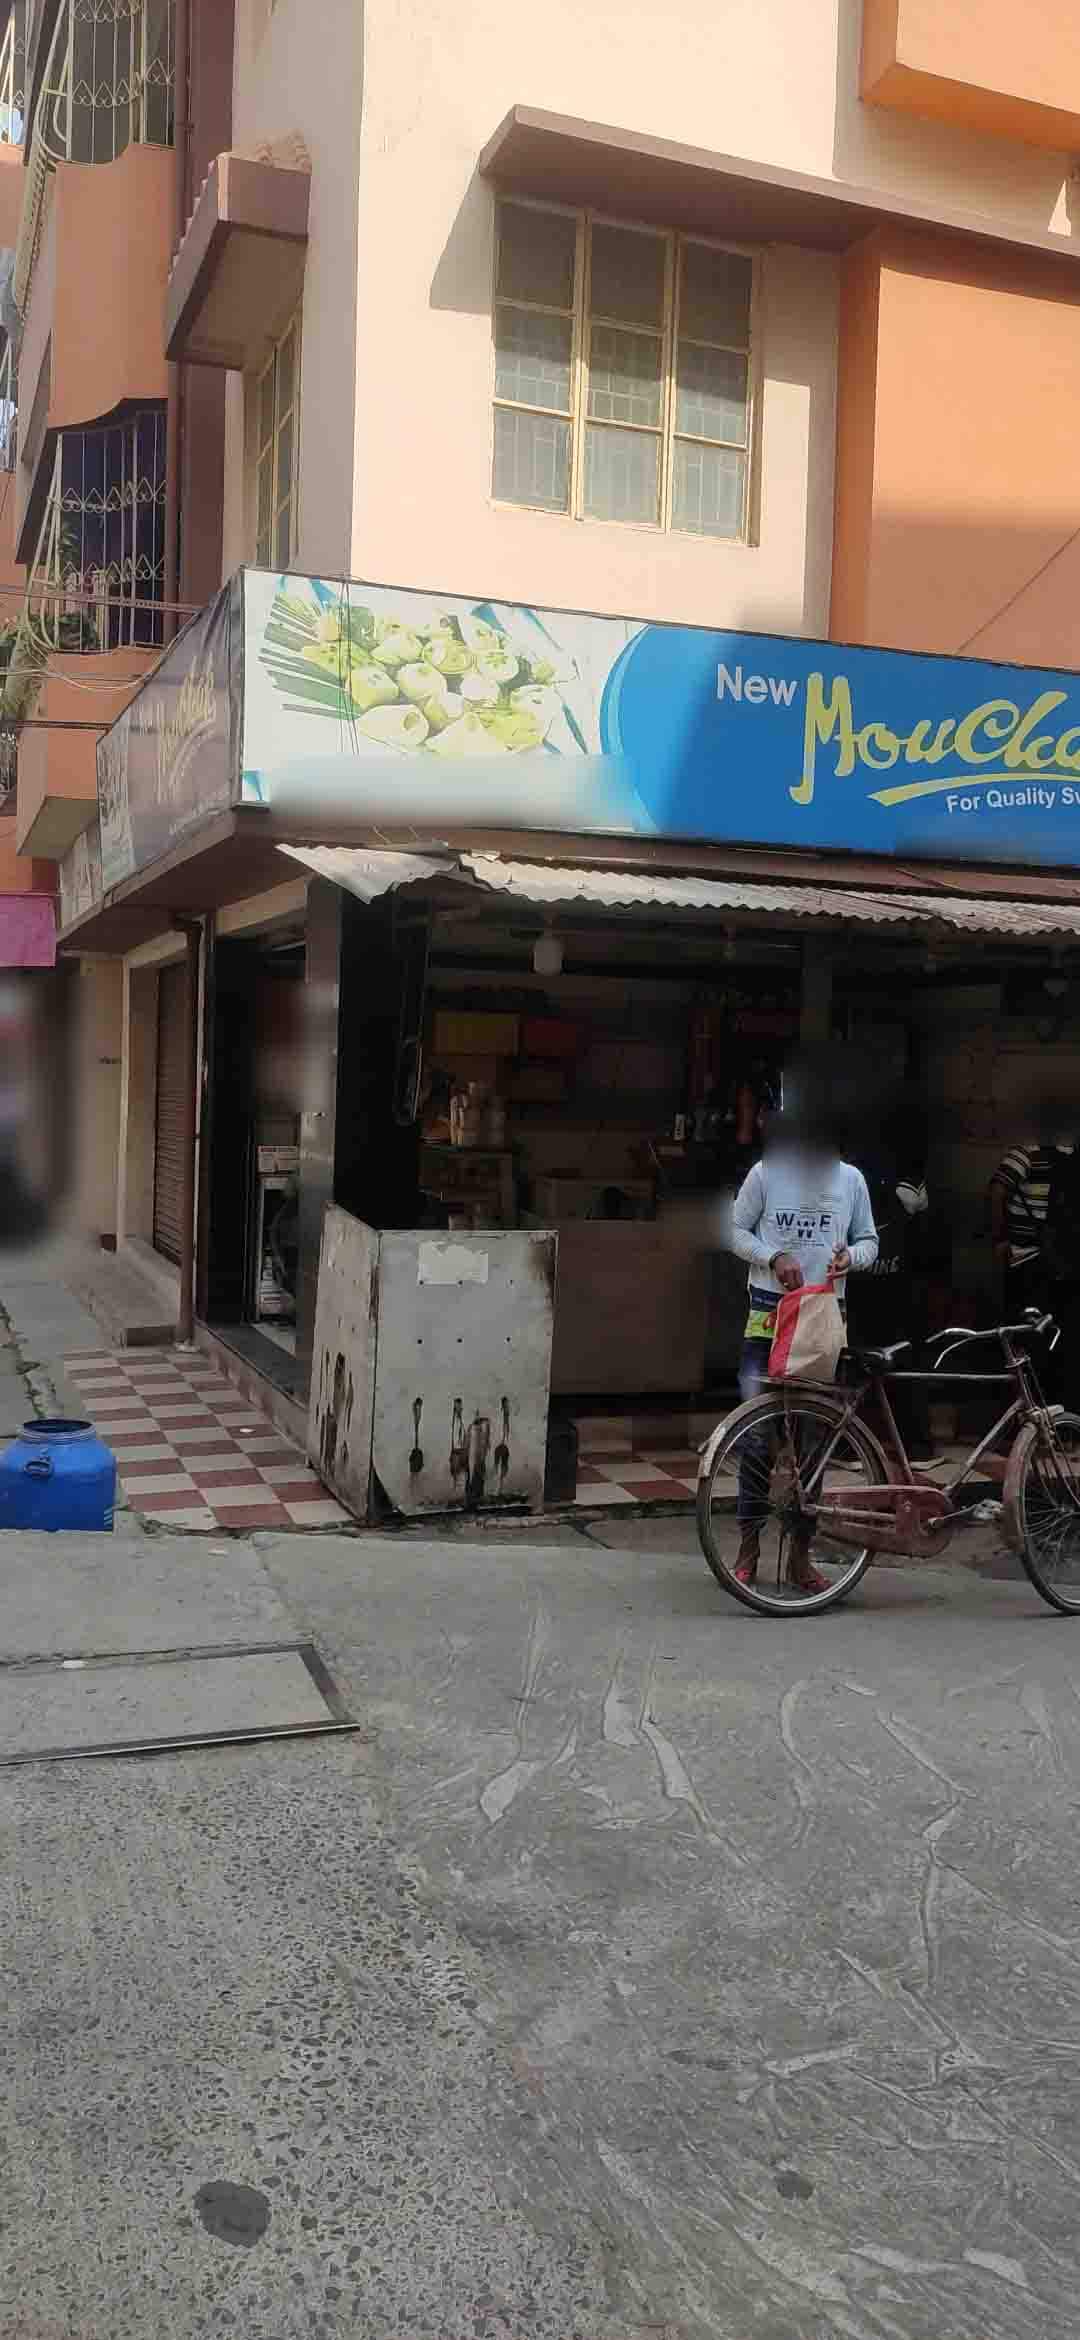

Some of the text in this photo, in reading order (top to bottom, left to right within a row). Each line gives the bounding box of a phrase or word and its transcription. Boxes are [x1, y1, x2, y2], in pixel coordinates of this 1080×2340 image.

[716, 663, 797, 706] New
[946, 794, 981, 814] For
[986, 787, 1055, 808] Quality
